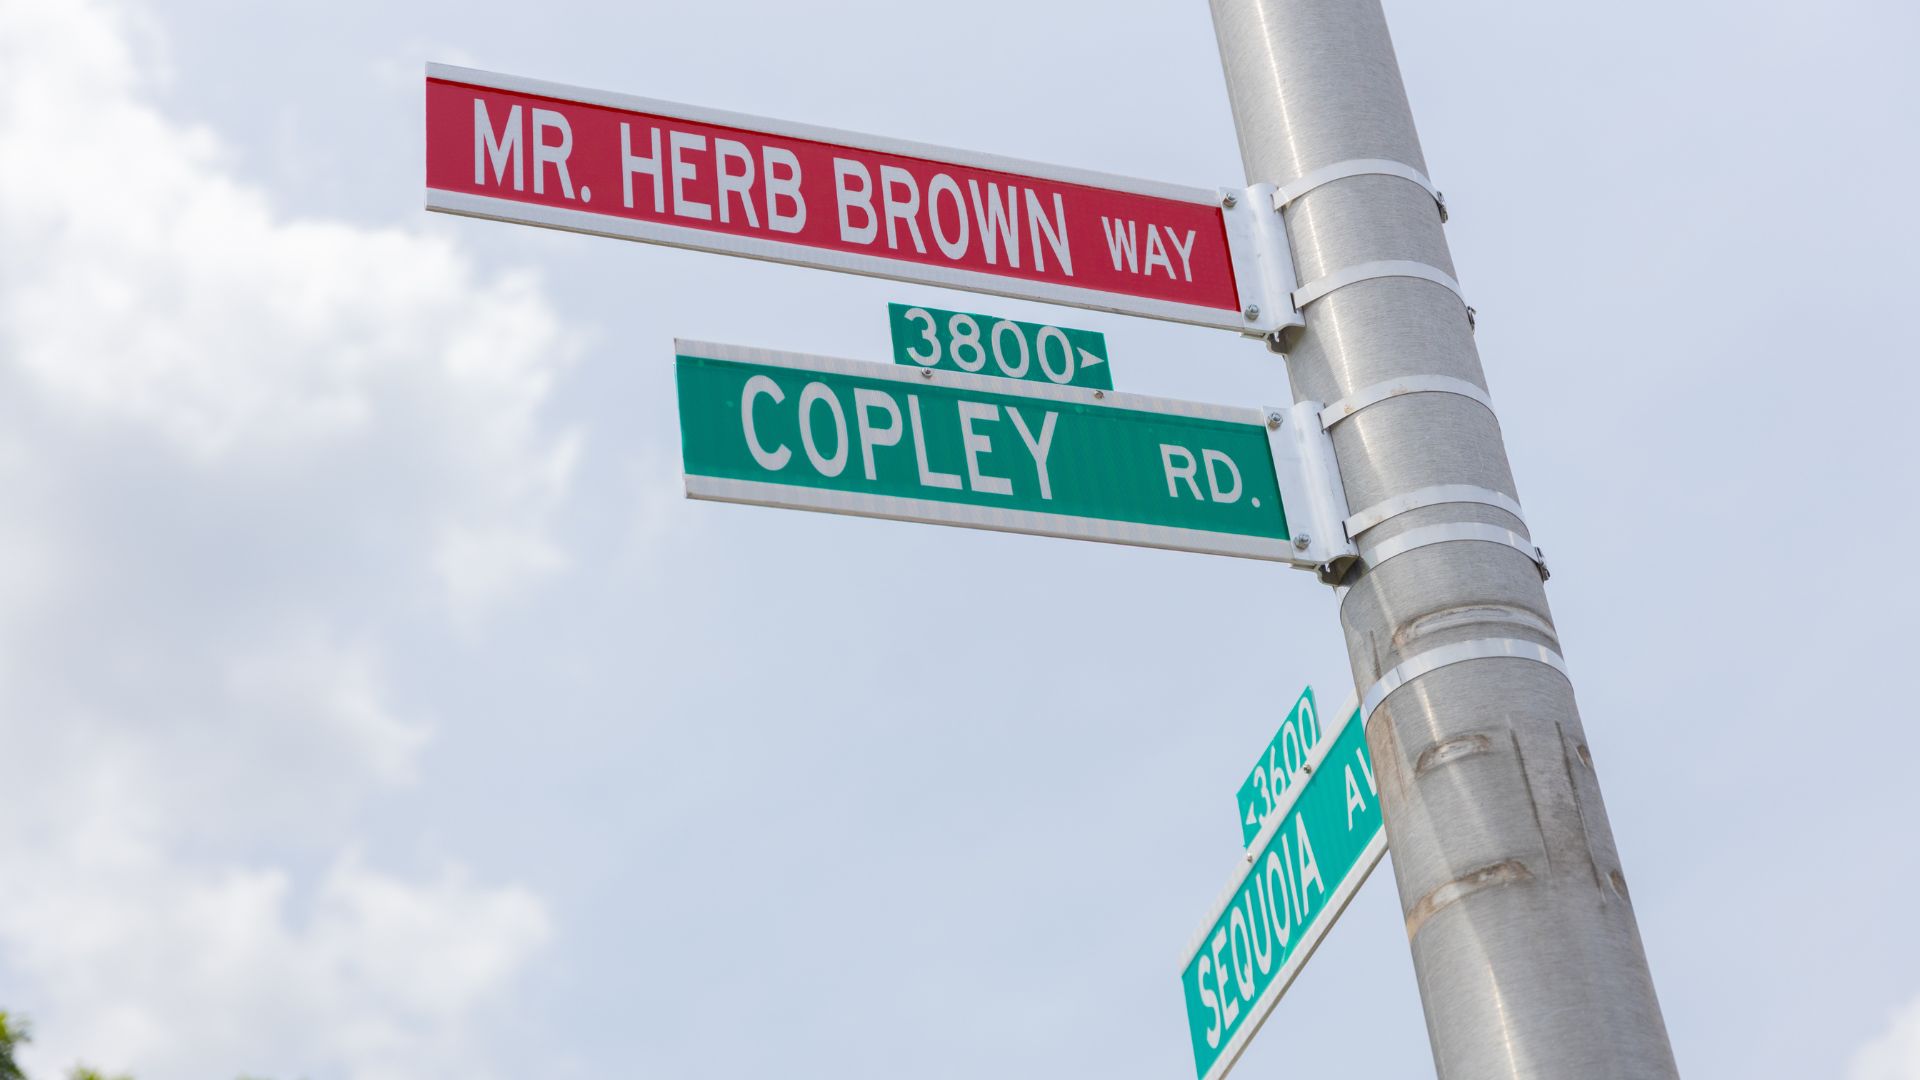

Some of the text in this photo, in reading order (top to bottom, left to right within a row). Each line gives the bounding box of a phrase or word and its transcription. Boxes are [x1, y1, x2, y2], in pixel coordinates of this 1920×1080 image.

[474, 98, 1196, 283] MR. HERB BROWN WAY
[906, 307, 1075, 386] 3800
[740, 375, 1261, 508] COPLEY RD.
[1253, 697, 1317, 827] 3600
[1198, 811, 1324, 1049] SEQUOIA
